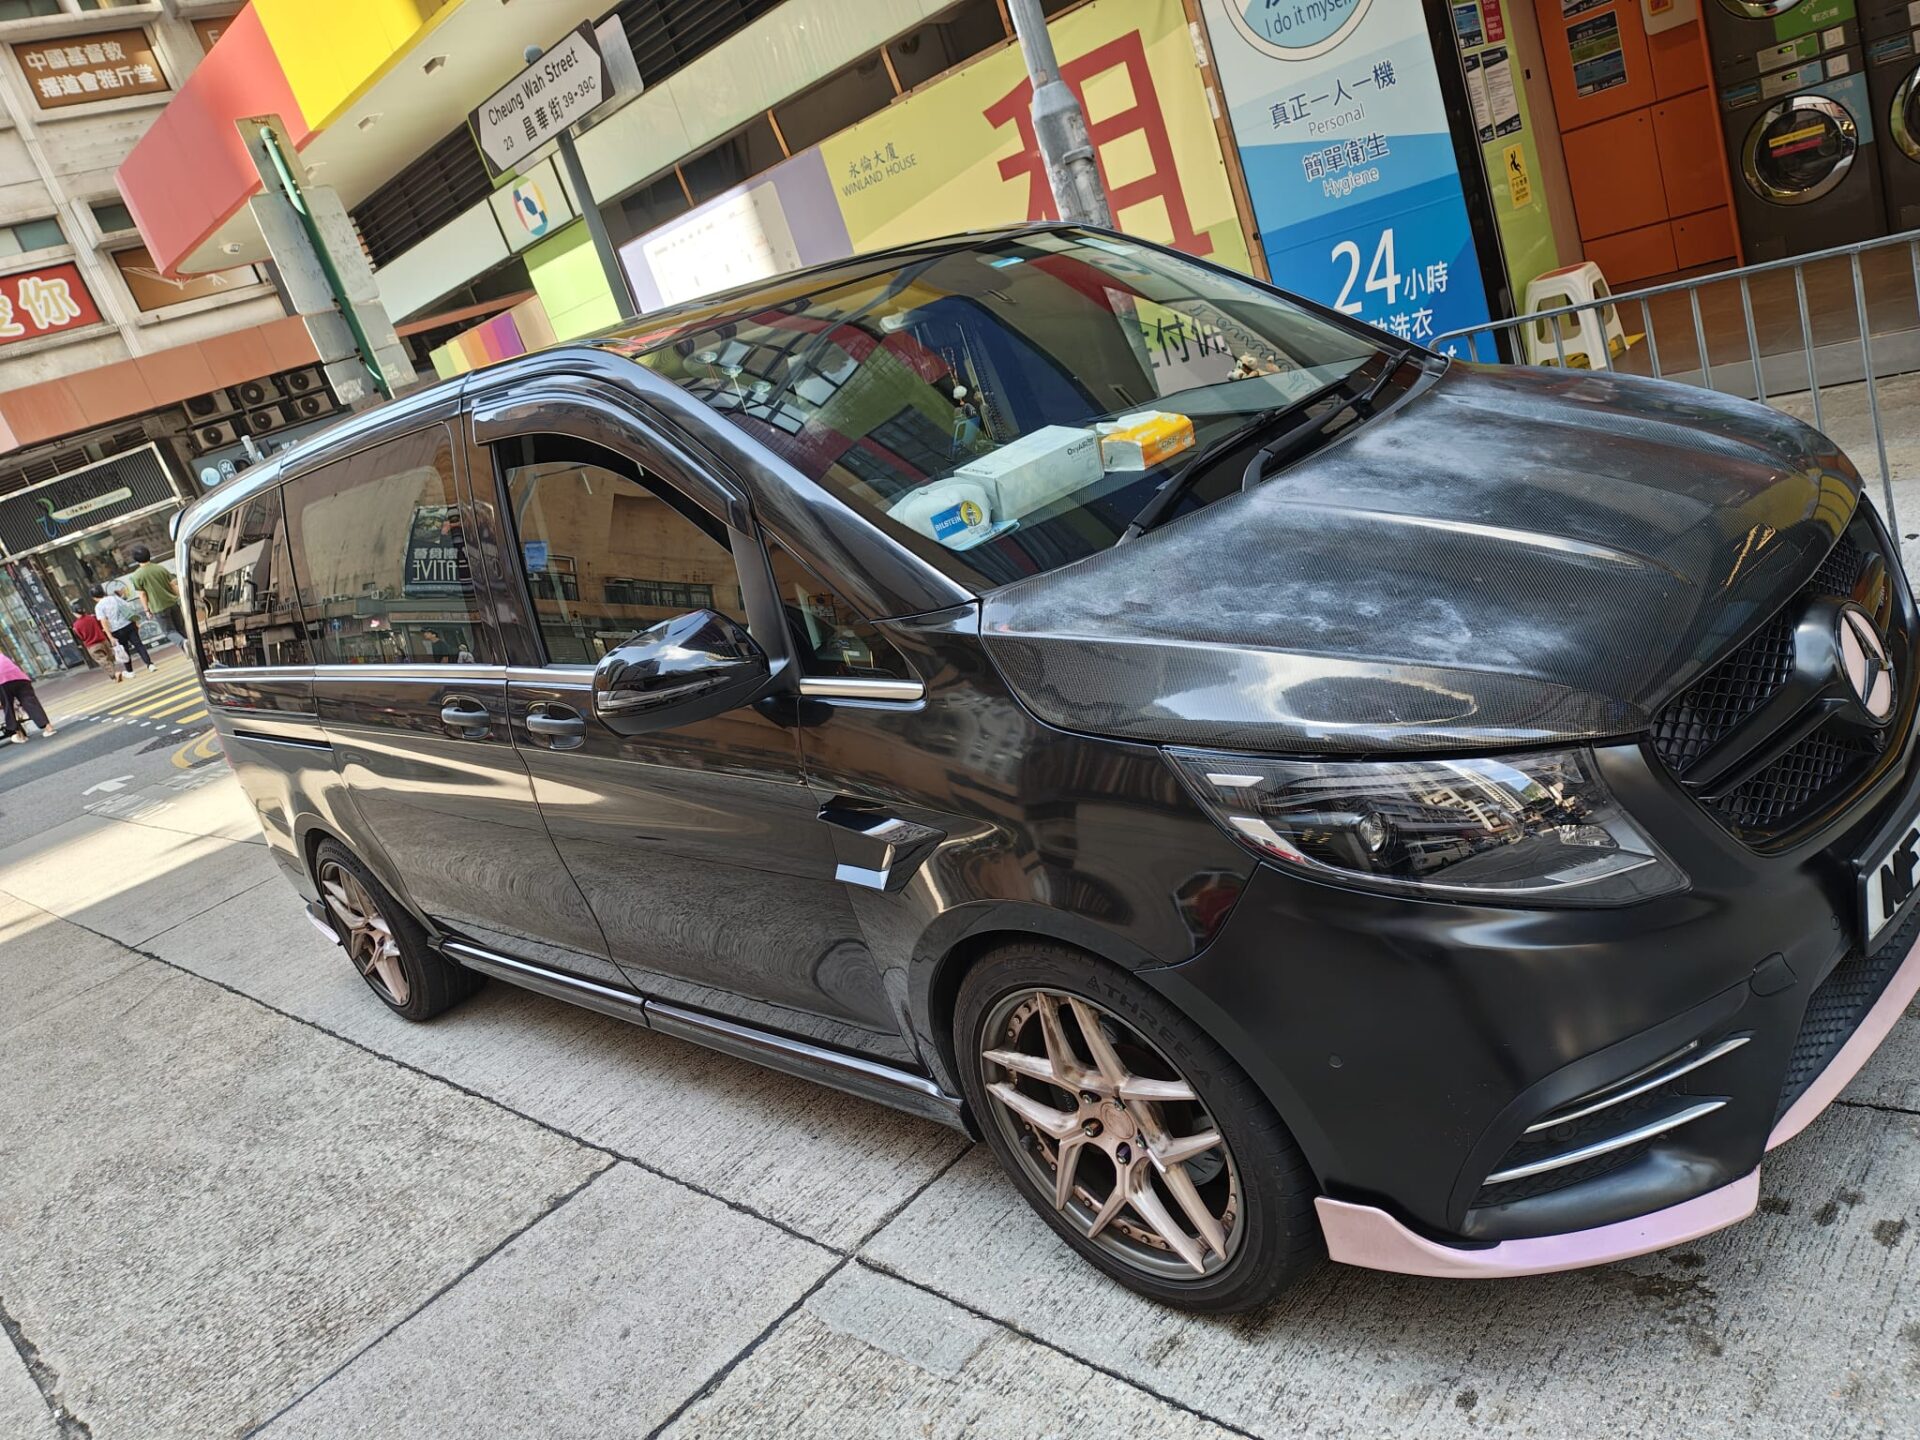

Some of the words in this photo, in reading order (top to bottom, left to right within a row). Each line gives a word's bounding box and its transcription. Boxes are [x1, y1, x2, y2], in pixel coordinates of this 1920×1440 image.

[1264, 18, 1271, 38] I
[1273, 12, 1292, 34] do
[1293, 5, 1305, 26] it
[1307, 0, 1352, 21] myse
[25, 41, 126, 72] 中國基督教
[488, 92, 525, 126] Cheung
[521, 73, 546, 99] Wah
[544, 47, 579, 83] Street
[1268, 59, 1397, 130] 真正一人一機
[503, 135, 515, 151] 23
[522, 97, 564, 141] 昌華街
[982, 29, 1214, 257] 租
[1308, 104, 1365, 136] Personal
[842, 170, 883, 197] WINLAND
[885, 153, 918, 177] HOUSE
[1302, 132, 1390, 181] 簡單衛生
[1323, 167, 1379, 198] Hygiene
[1331, 228, 1401, 315] 24
[1404, 261, 1448, 300] 小時
[934, 514, 962, 532] BILSTEIN
